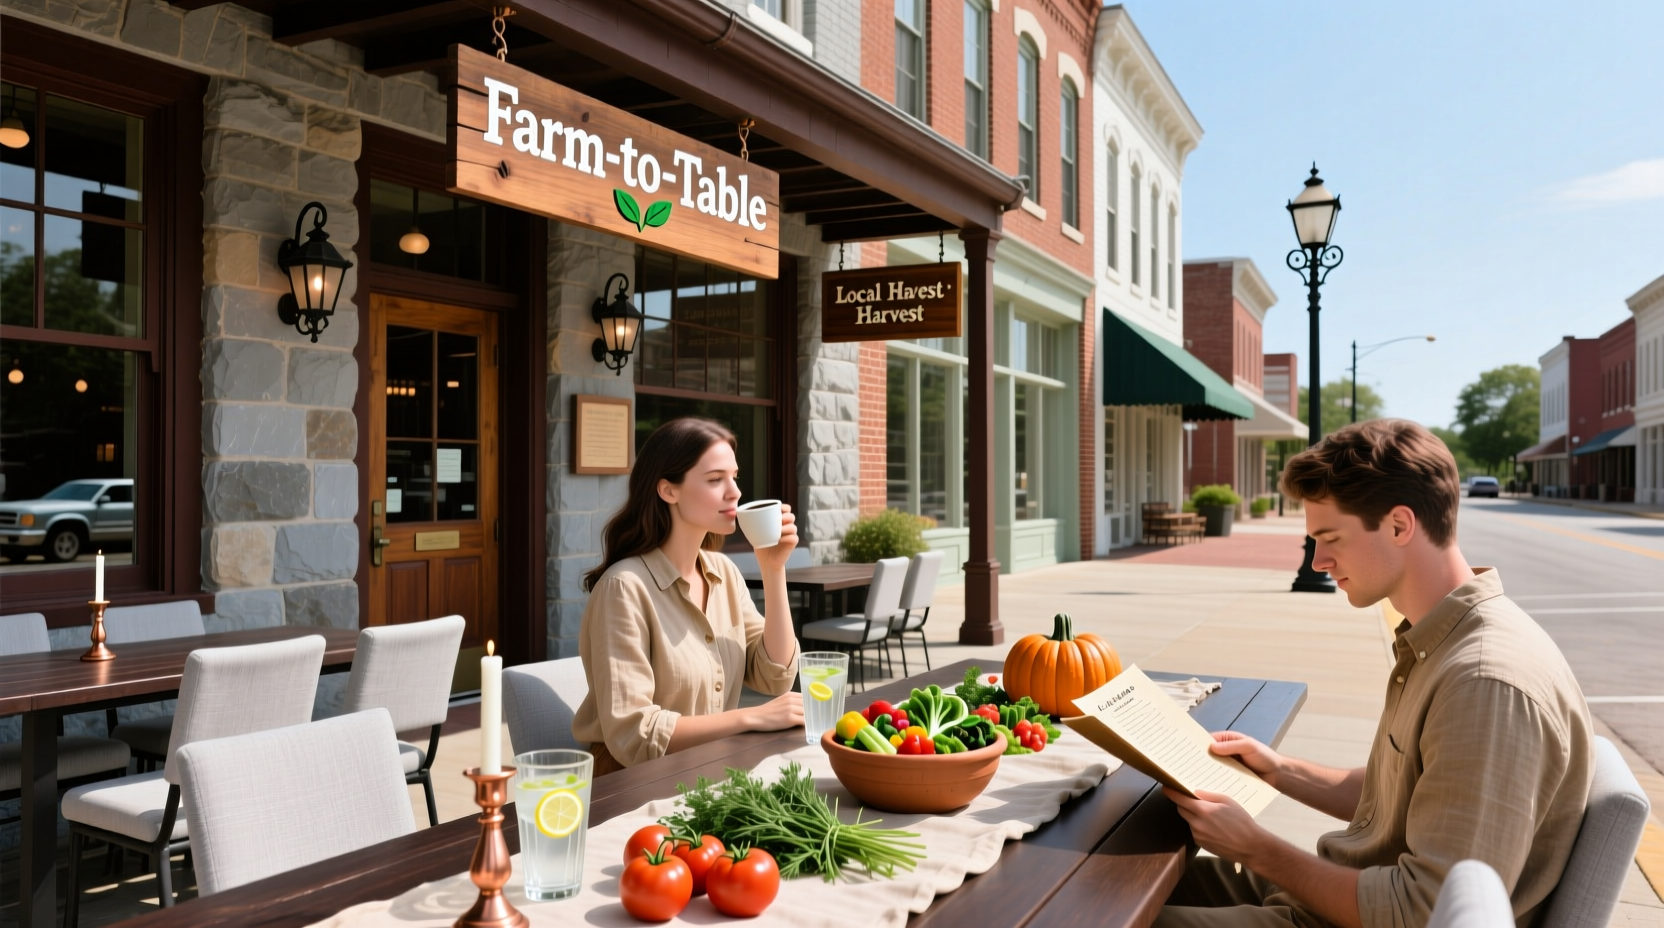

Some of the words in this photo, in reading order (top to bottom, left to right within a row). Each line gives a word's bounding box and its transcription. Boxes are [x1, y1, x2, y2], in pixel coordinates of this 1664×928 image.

[483, 76, 767, 231] Farm-to-Table
[835, 282, 882, 304] Local
[855, 305, 924, 325] Harvest
